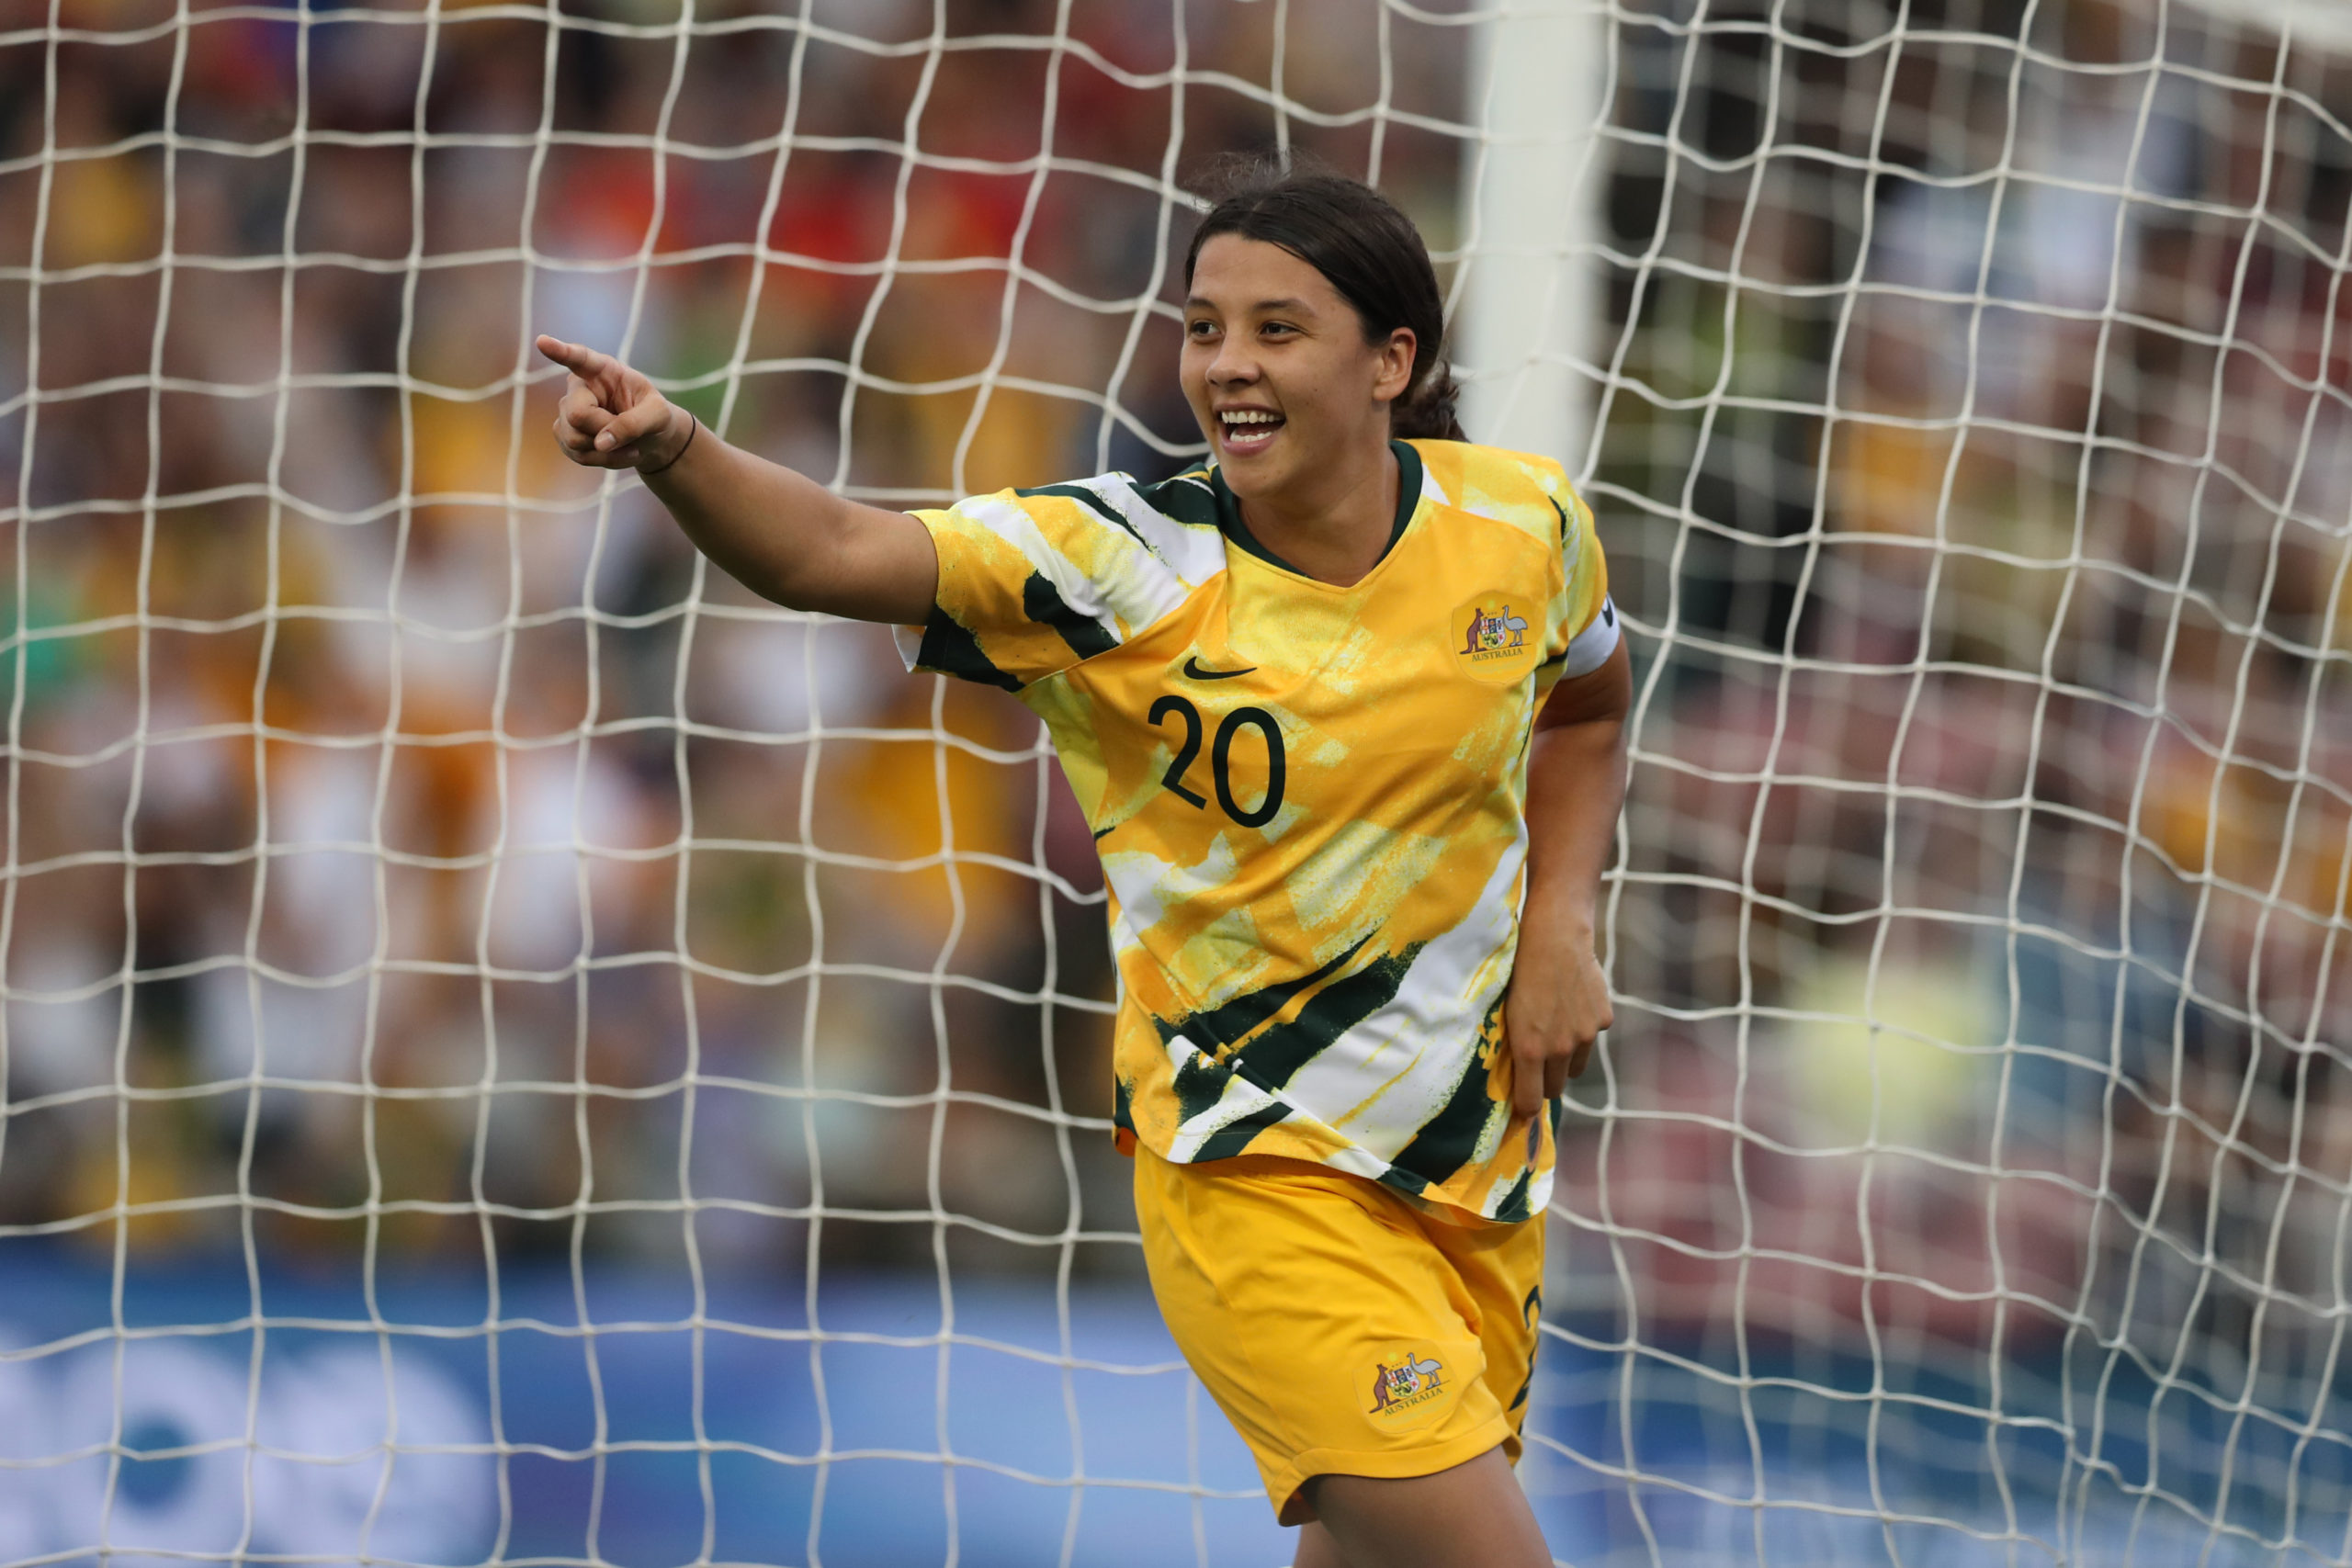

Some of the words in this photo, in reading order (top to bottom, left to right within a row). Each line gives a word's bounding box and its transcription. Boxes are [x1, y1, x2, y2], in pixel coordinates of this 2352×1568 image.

[1472, 648, 1522, 661] AUSTRALIA
[1148, 695, 1285, 828] 20
[1385, 1387, 1442, 1416] AUSTRALIA
